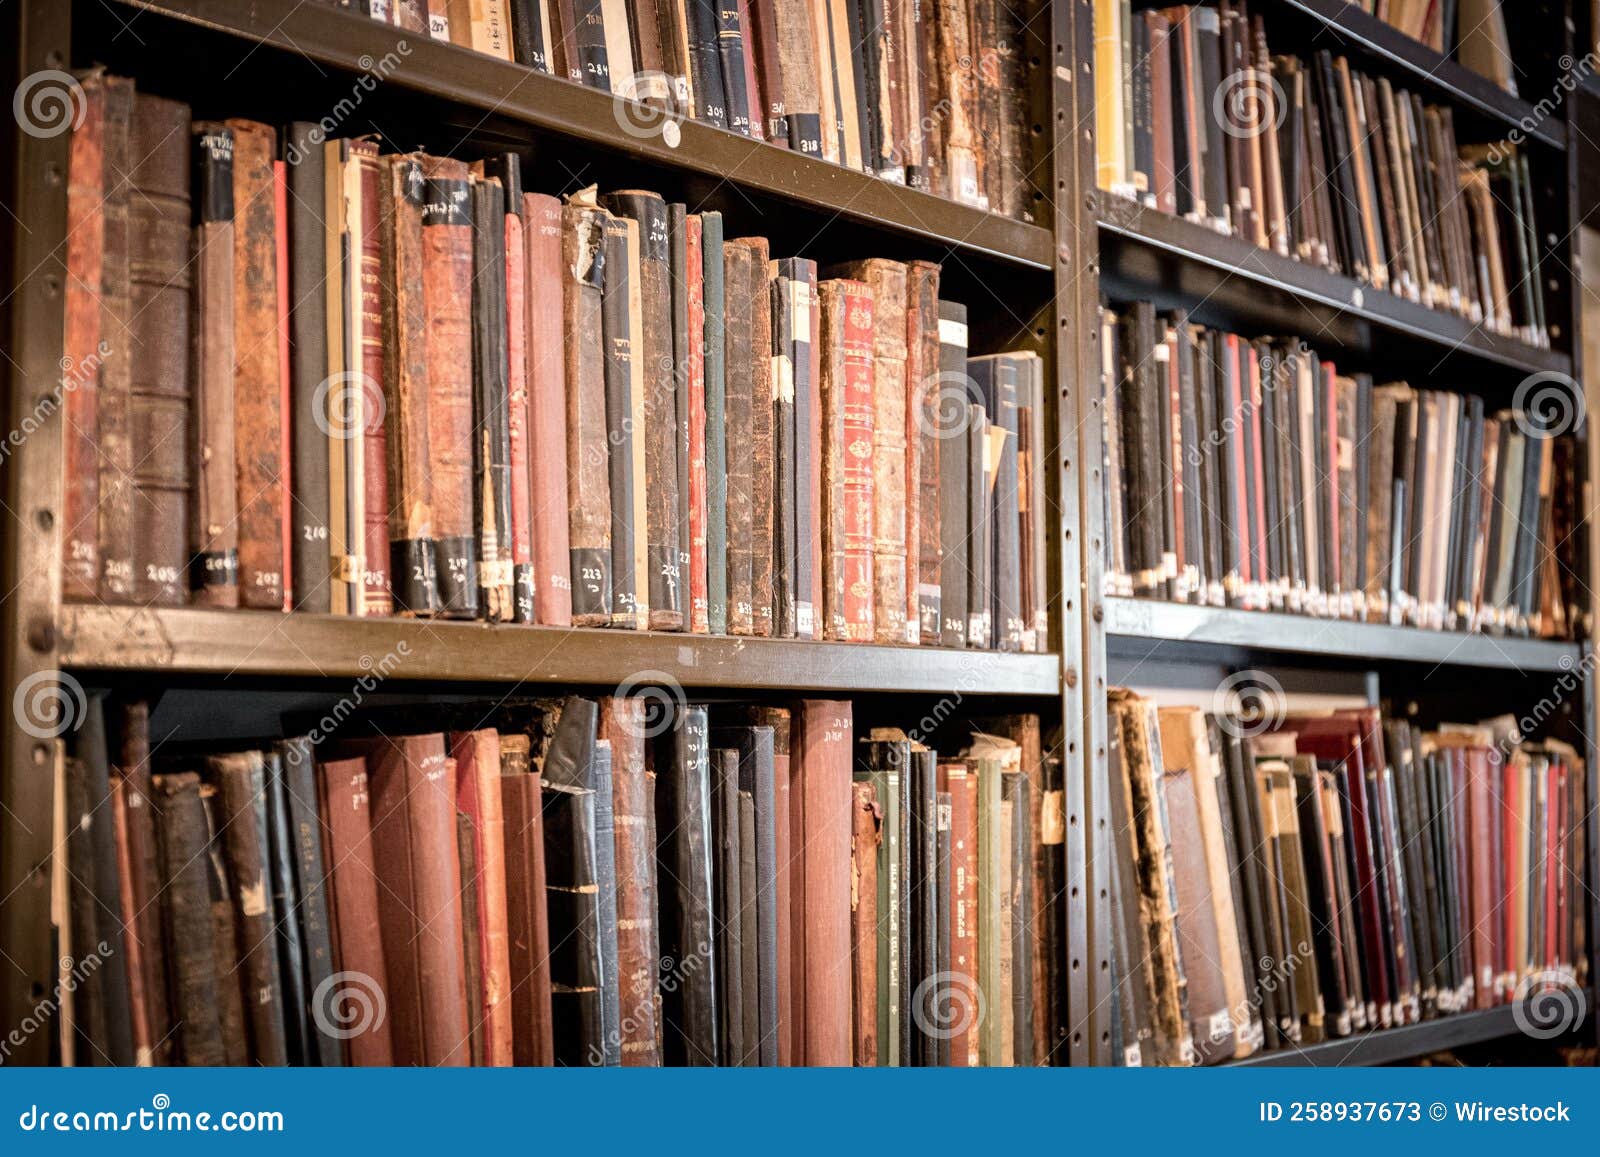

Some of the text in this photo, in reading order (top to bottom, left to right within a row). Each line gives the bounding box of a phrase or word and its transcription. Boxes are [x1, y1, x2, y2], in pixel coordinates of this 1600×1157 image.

[587, 62, 609, 76] 284
[707, 104, 724, 119] 309
[800, 139, 818, 153] 318
